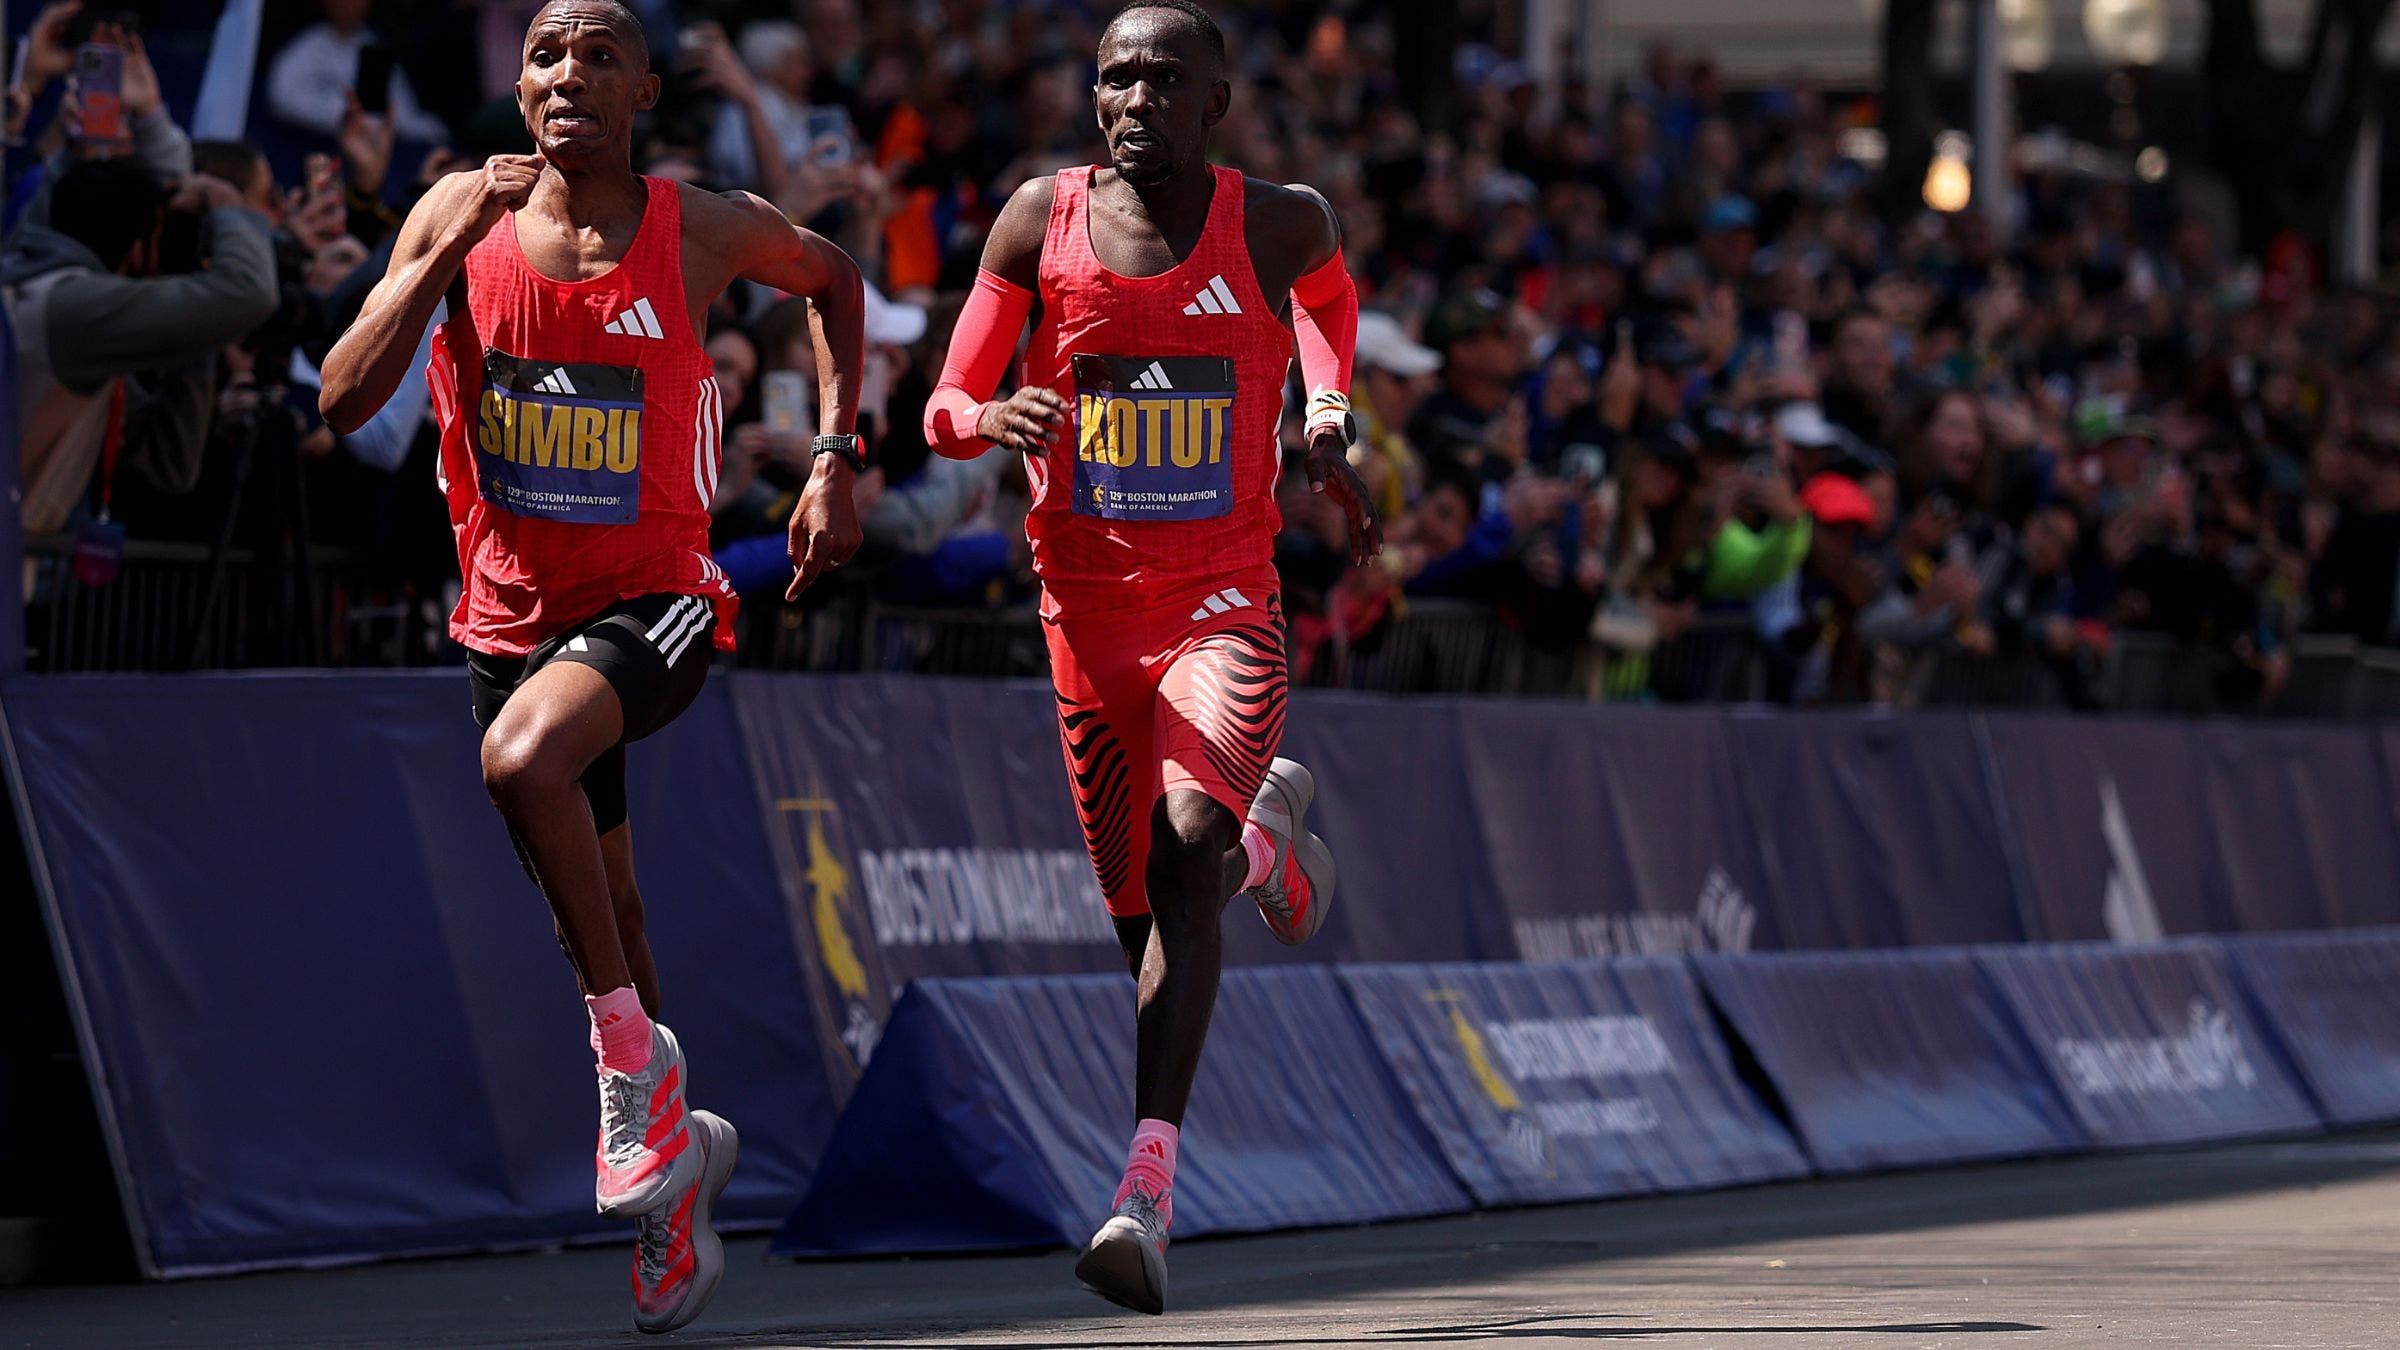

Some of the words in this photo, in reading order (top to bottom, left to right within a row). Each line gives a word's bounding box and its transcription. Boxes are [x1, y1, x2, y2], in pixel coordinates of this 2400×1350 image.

[479, 389, 640, 474] SIMBU
[1079, 394, 1233, 469] KOTUT
[526, 493, 563, 503] BOSTON
[565, 494, 620, 506] MARATHON
[1127, 492, 1166, 502] BOSTON
[1168, 489, 1217, 502] MARATHON
[537, 504, 571, 512] AMERICA
[1110, 502, 1128, 510] BANK
